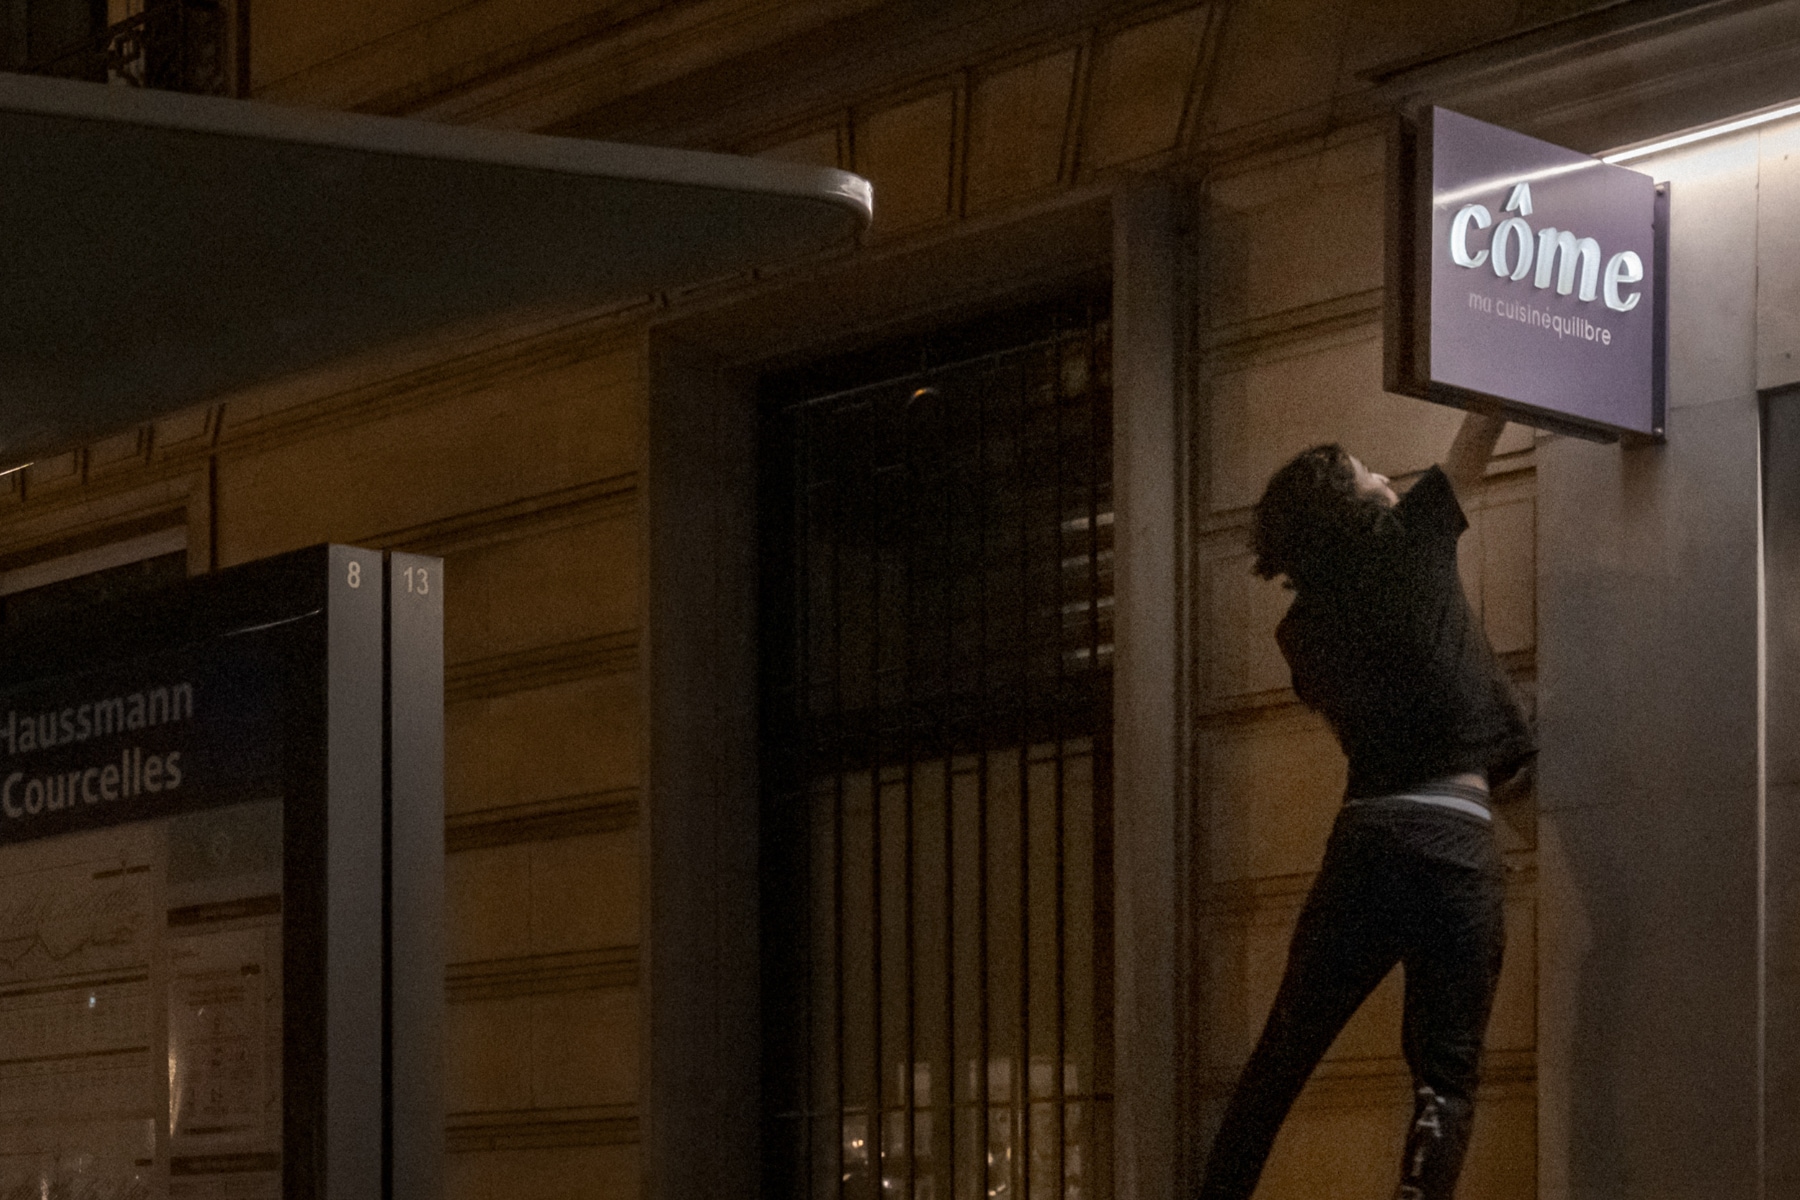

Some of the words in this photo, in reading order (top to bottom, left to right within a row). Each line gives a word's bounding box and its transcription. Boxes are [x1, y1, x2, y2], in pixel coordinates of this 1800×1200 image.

[1450, 182, 1644, 313] côme
[1468, 292, 1492, 314] ma
[347, 560, 361, 589] 8
[403, 566, 430, 596] 13
[2, 747, 184, 819] Courcelles
